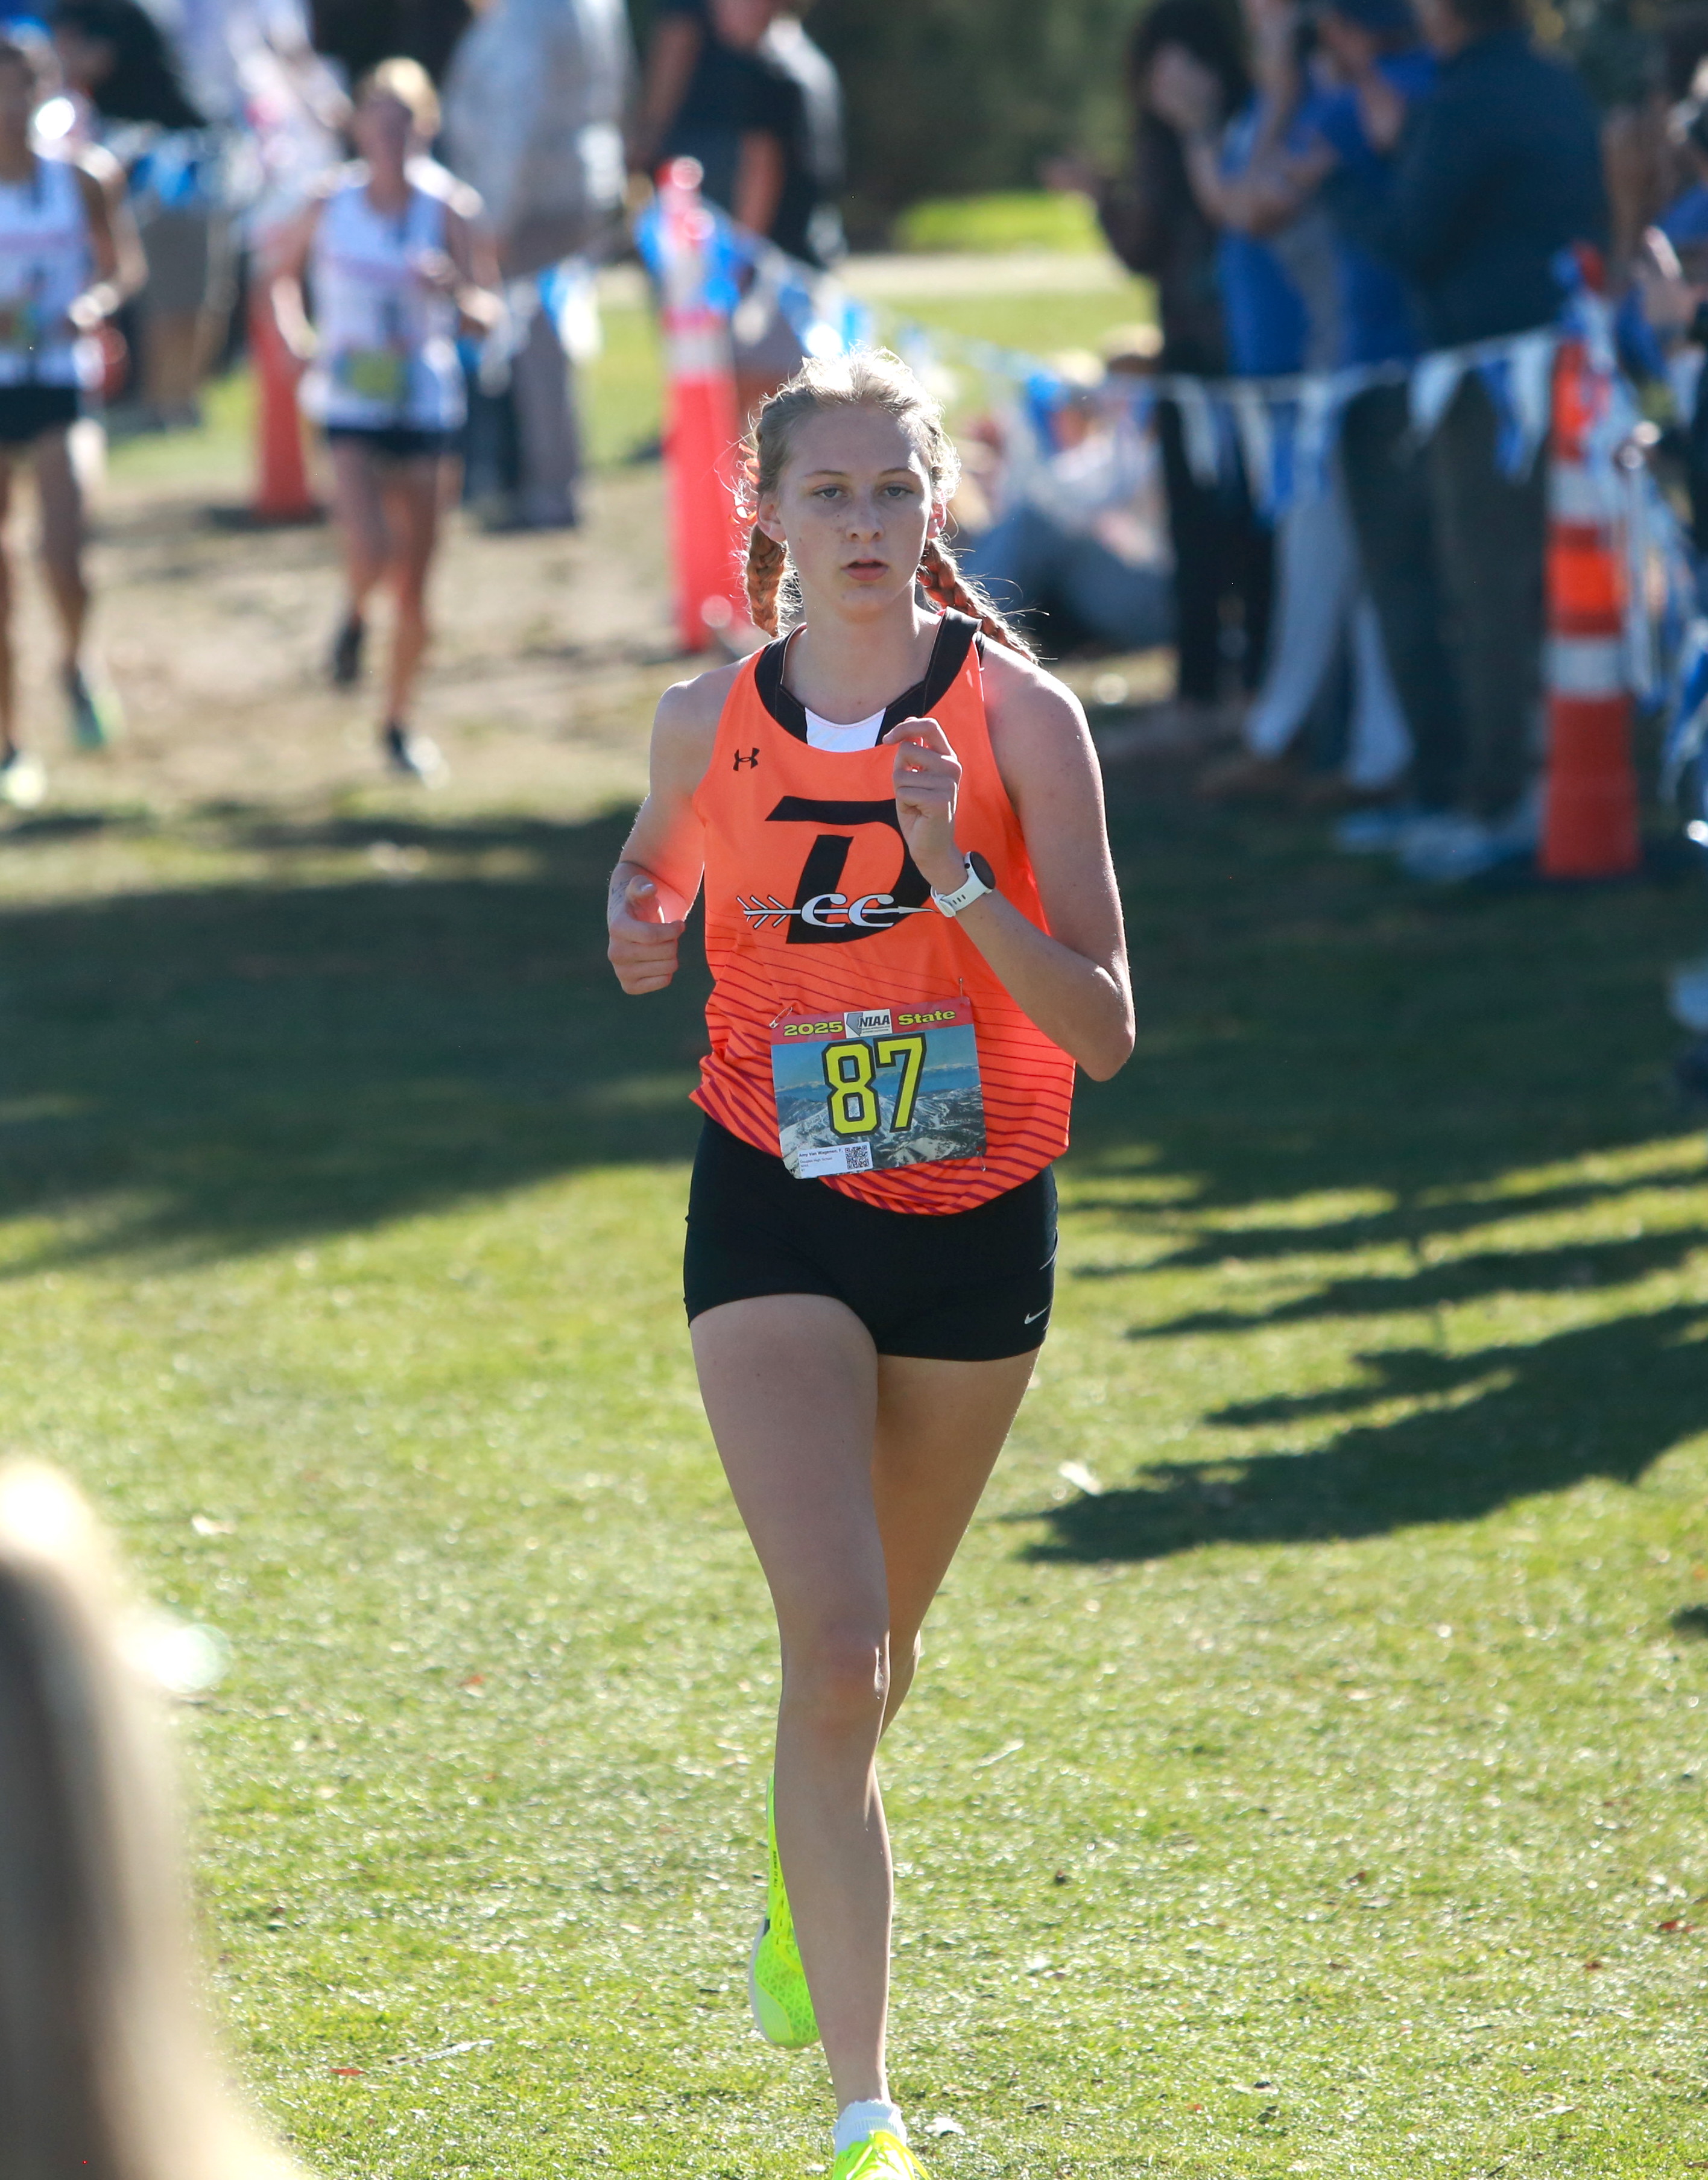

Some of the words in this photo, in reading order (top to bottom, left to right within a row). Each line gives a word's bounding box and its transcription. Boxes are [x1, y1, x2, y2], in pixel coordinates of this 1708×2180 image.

[765, 795, 933, 944] D
[783, 1020, 844, 1037] 2025
[859, 1014, 891, 1028] NIAA
[898, 1010, 955, 1026] State
[821, 1032, 927, 1139] 87
